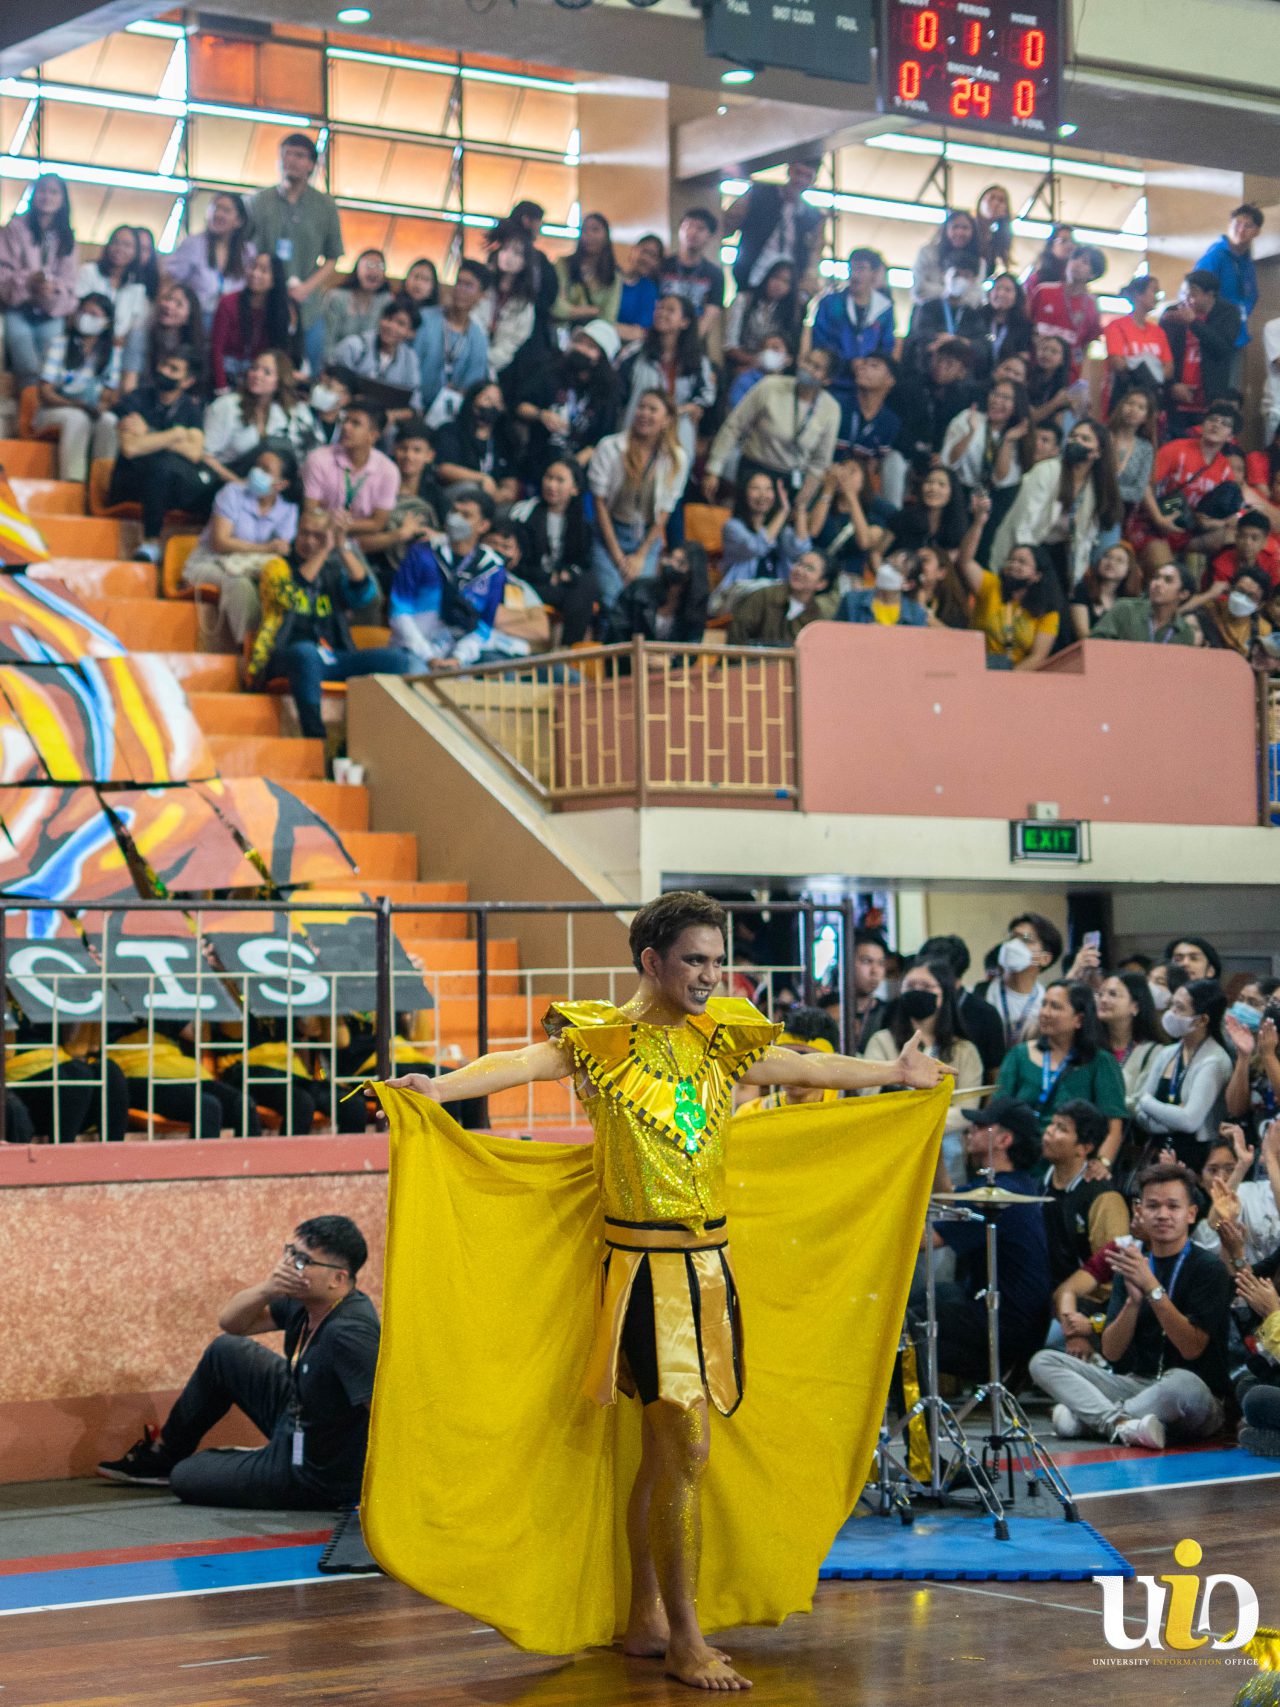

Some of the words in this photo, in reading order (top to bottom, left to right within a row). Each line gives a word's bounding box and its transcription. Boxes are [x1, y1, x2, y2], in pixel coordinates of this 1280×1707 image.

[916, 11, 938, 51] 0
[969, 21, 981, 56] 1
[1023, 30, 1045, 68] 0
[899, 60, 921, 100] 0
[950, 77, 992, 118] 24
[1013, 79, 1036, 118] 0
[1024, 828, 1072, 850] EXIT
